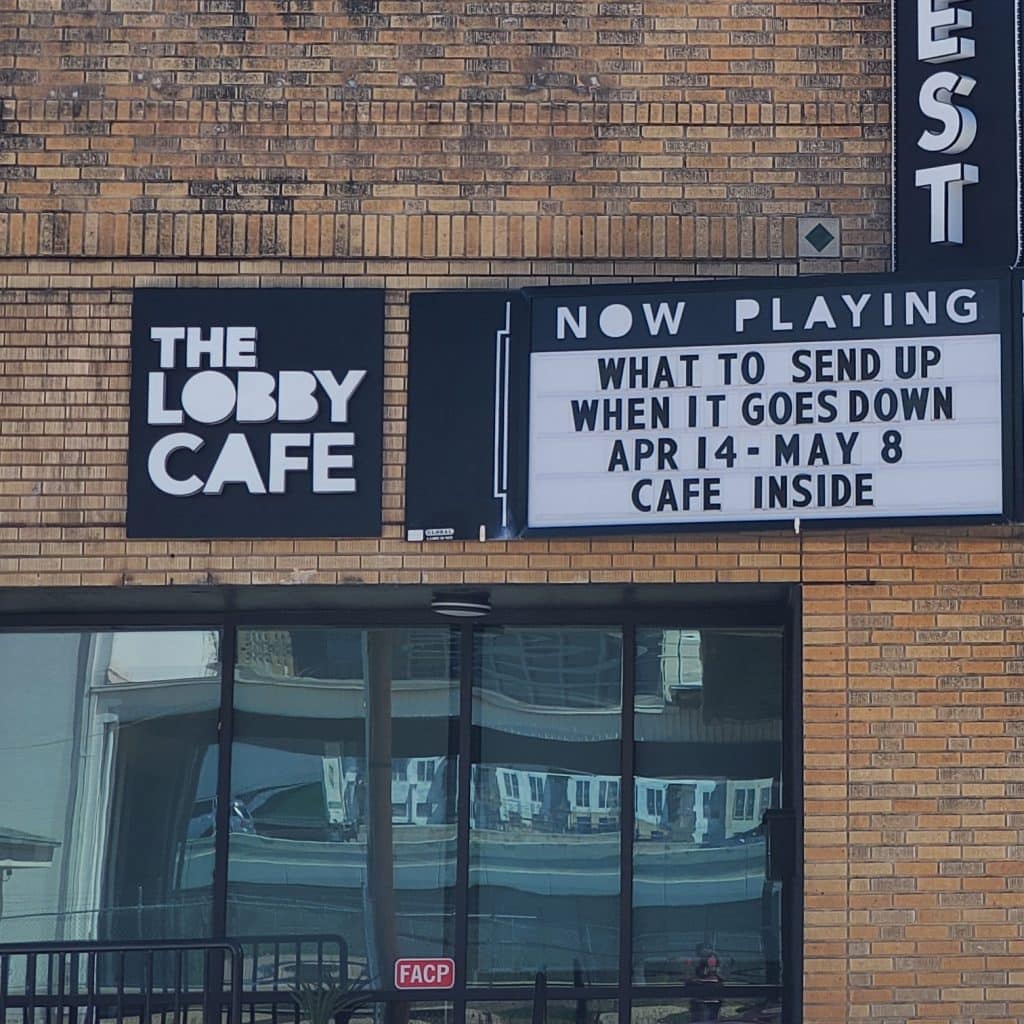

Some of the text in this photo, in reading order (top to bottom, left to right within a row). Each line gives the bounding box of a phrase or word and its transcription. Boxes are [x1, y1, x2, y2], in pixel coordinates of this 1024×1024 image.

[556, 288, 979, 340] NOW PLAYING
[150, 326, 257, 368] THE
[597, 346, 941, 390] WHAT TO SEND UP
[148, 370, 367, 424] LOBBY
[571, 386, 954, 432] WHEN IT GOES DOWN
[148, 432, 357, 496] CAFE
[608, 437, 678, 472] APR
[880, 430, 903, 463] 8
[631, 473, 874, 513] CAFE INSIDE
[400, 964, 450, 984] FACP
